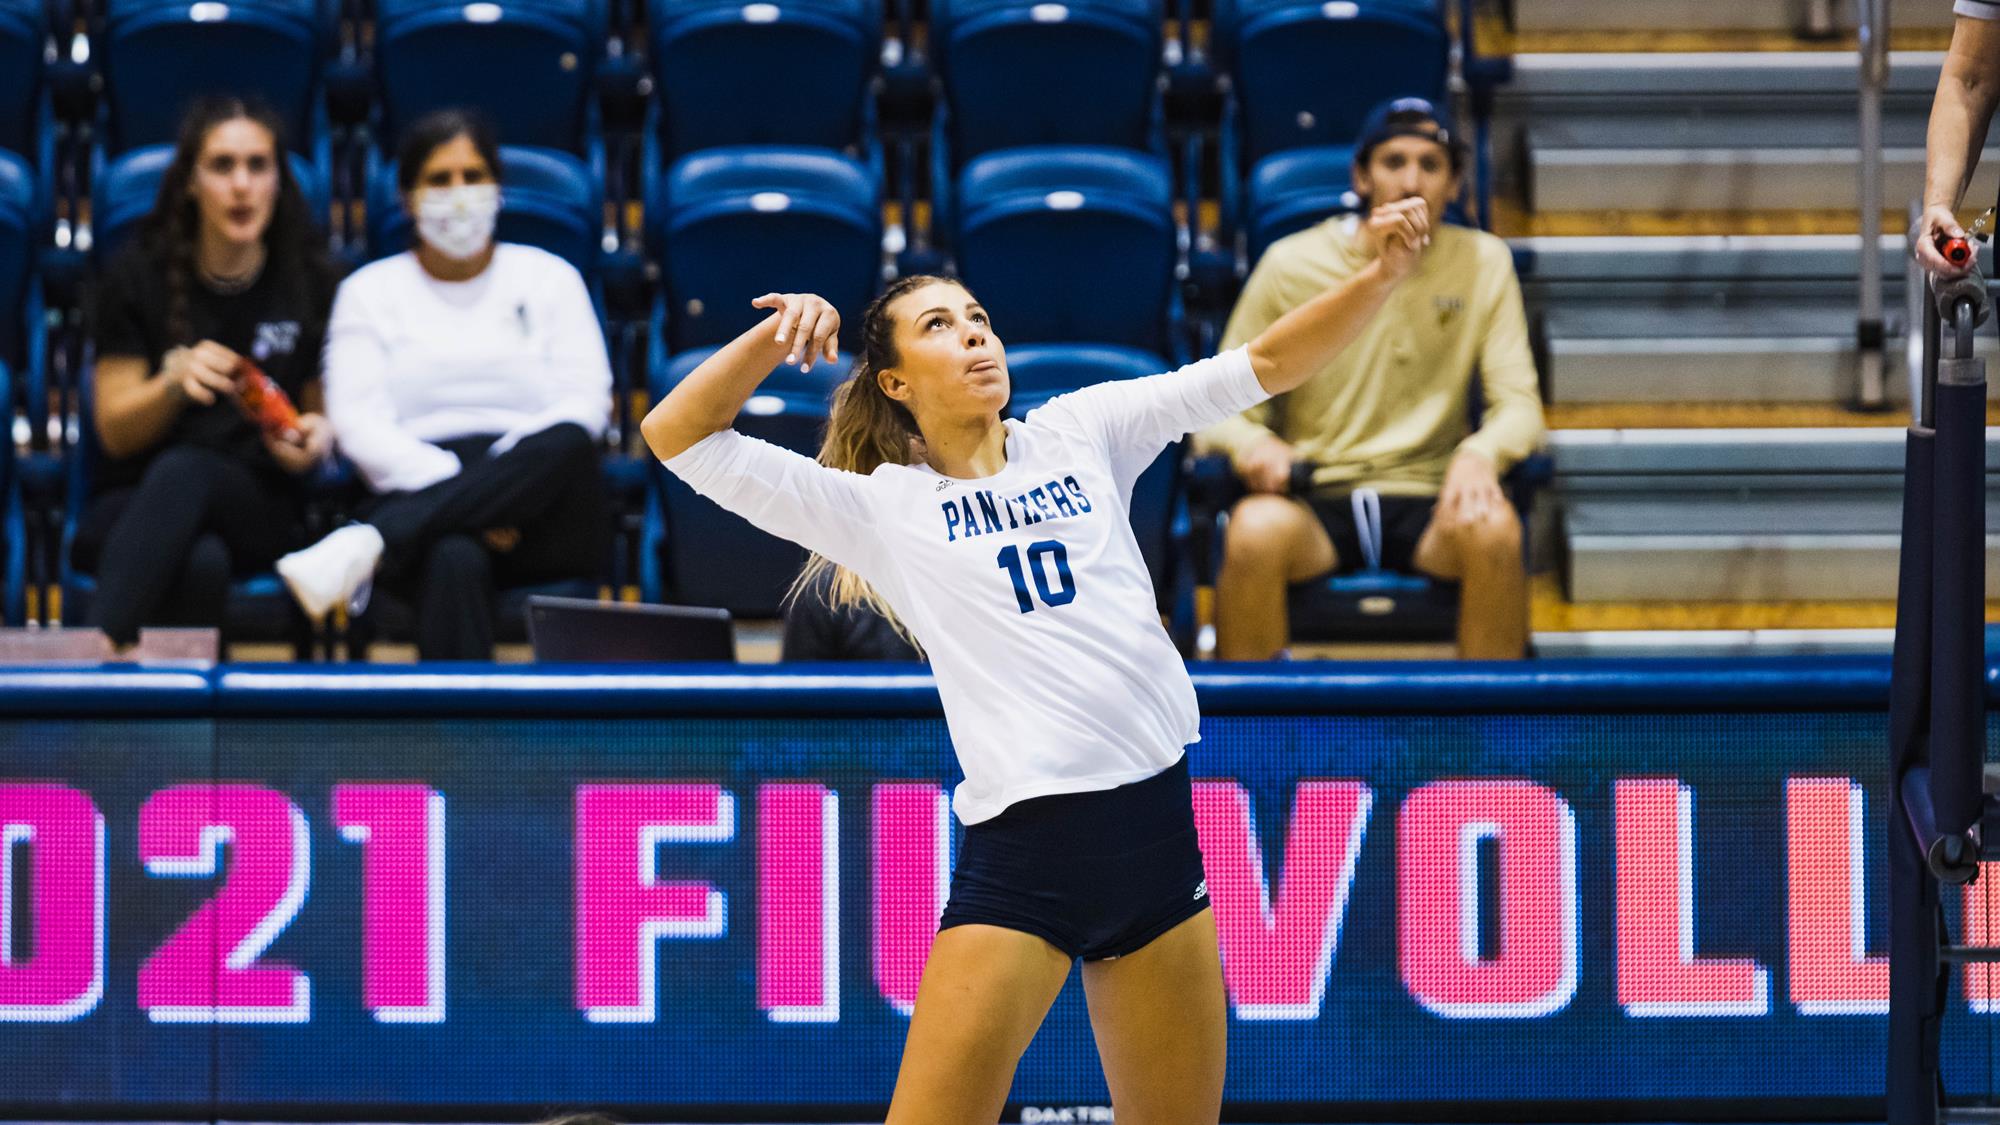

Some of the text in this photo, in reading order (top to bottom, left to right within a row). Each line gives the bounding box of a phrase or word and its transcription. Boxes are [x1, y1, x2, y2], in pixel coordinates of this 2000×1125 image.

[997, 539, 1077, 614] 10
[1190, 776, 2000, 1020] VOLL
[1021, 1106, 1115, 1123] DAKTR
